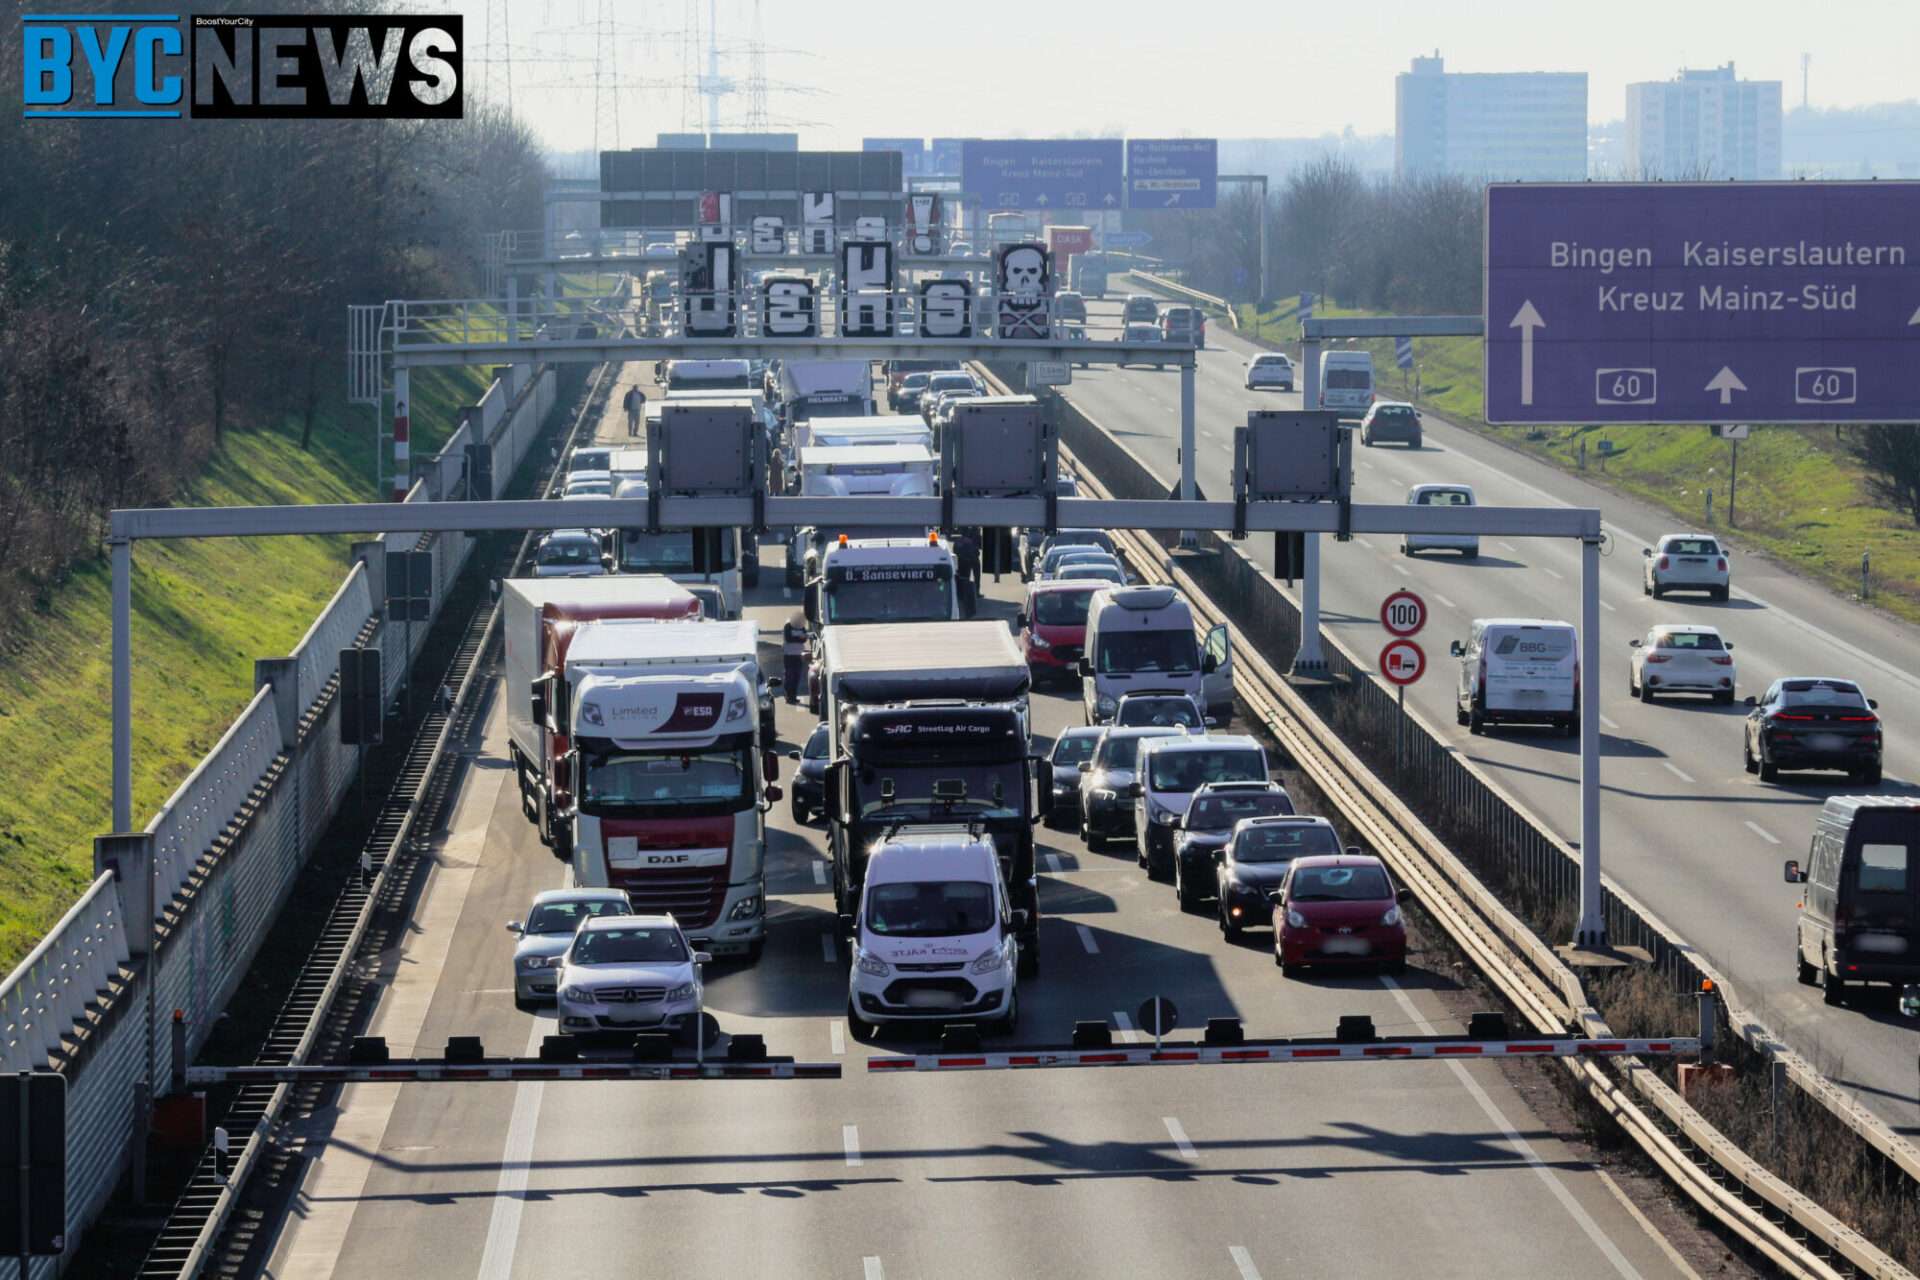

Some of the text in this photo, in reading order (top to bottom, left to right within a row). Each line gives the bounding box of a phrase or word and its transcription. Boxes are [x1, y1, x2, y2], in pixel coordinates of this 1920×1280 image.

[1550, 240, 1906, 274] Bingen Kaiserslautern
[1598, 284, 1858, 312] Kreuz Mainz-Süd
[1611, 375, 1641, 398] 60
[1811, 375, 1841, 397] 60
[1389, 604, 1418, 626] 100
[1519, 642, 1547, 653] BBG
[647, 854, 689, 864] DAF
